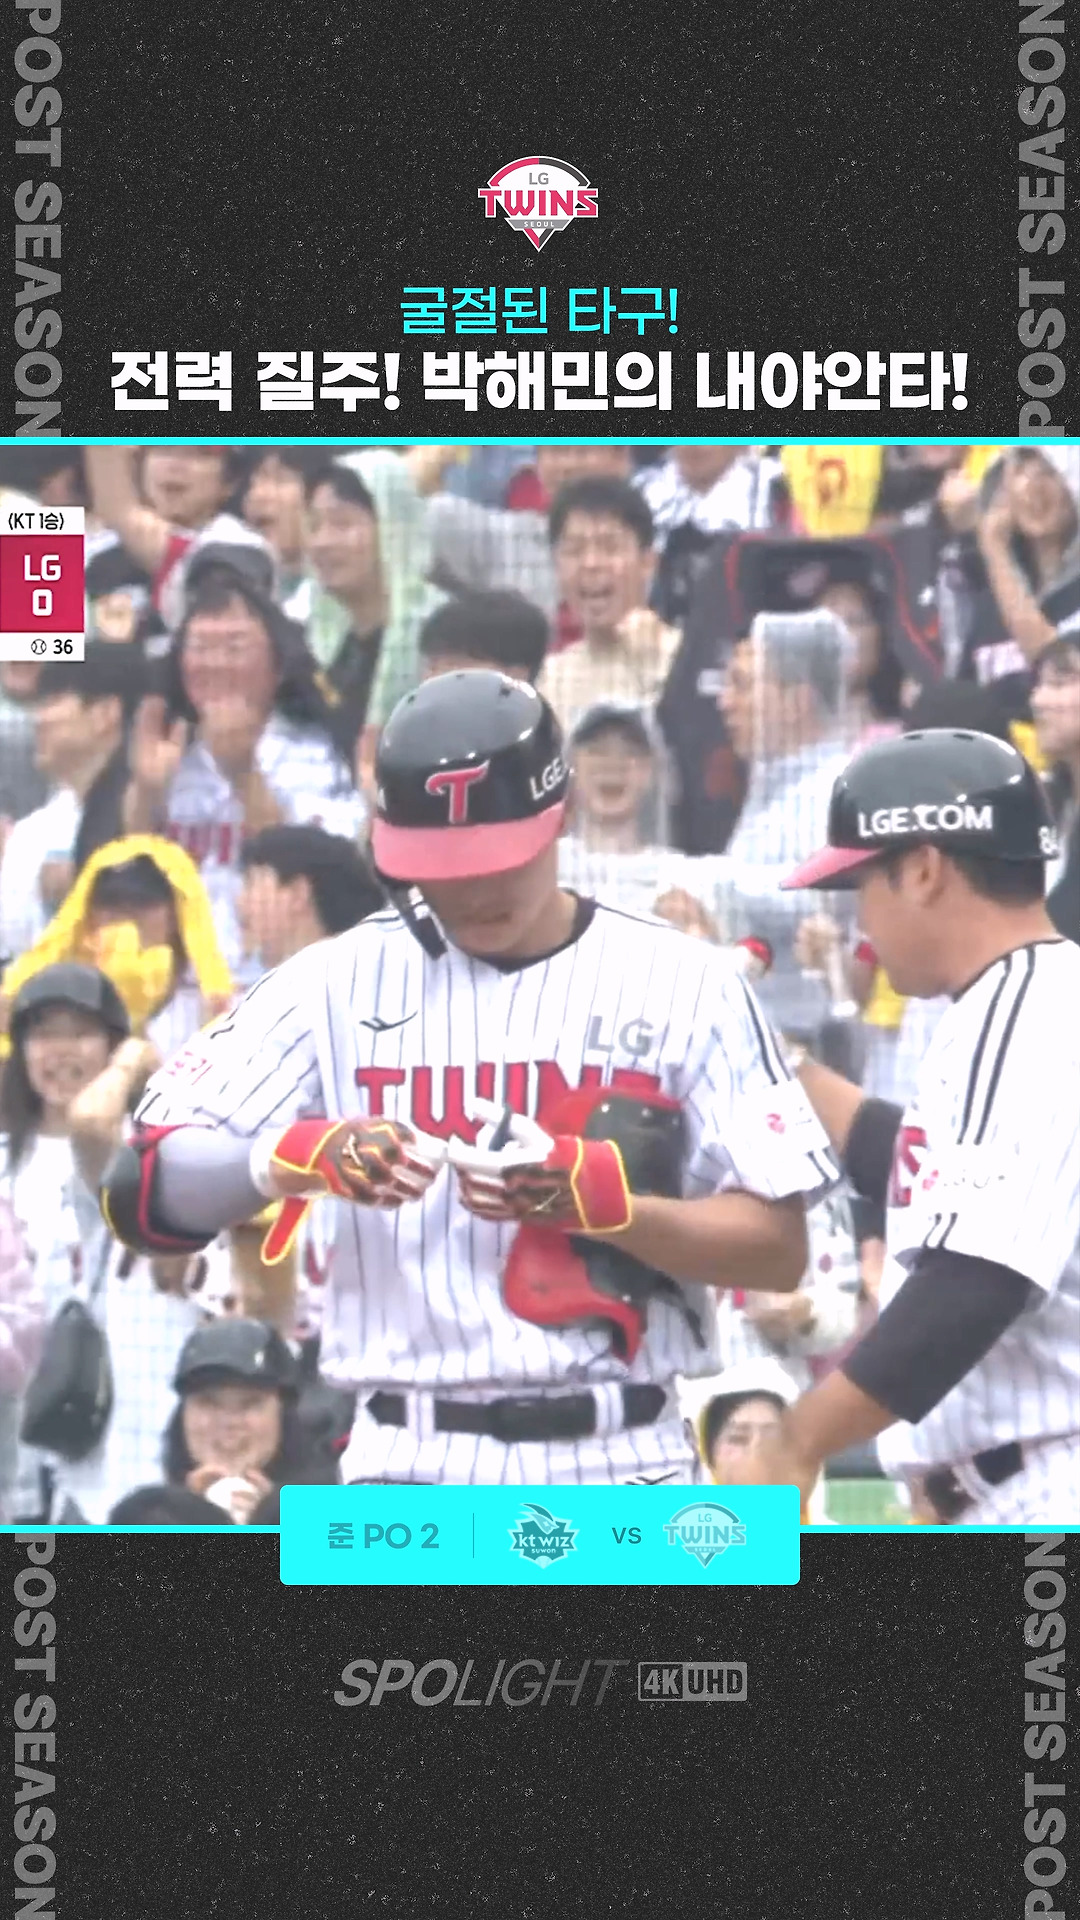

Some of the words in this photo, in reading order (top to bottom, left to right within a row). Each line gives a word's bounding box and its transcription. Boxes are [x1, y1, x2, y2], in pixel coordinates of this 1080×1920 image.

[425, 759, 490, 823] T
[858, 804, 994, 838] LGE.COM
[587, 1015, 654, 1057] LG
